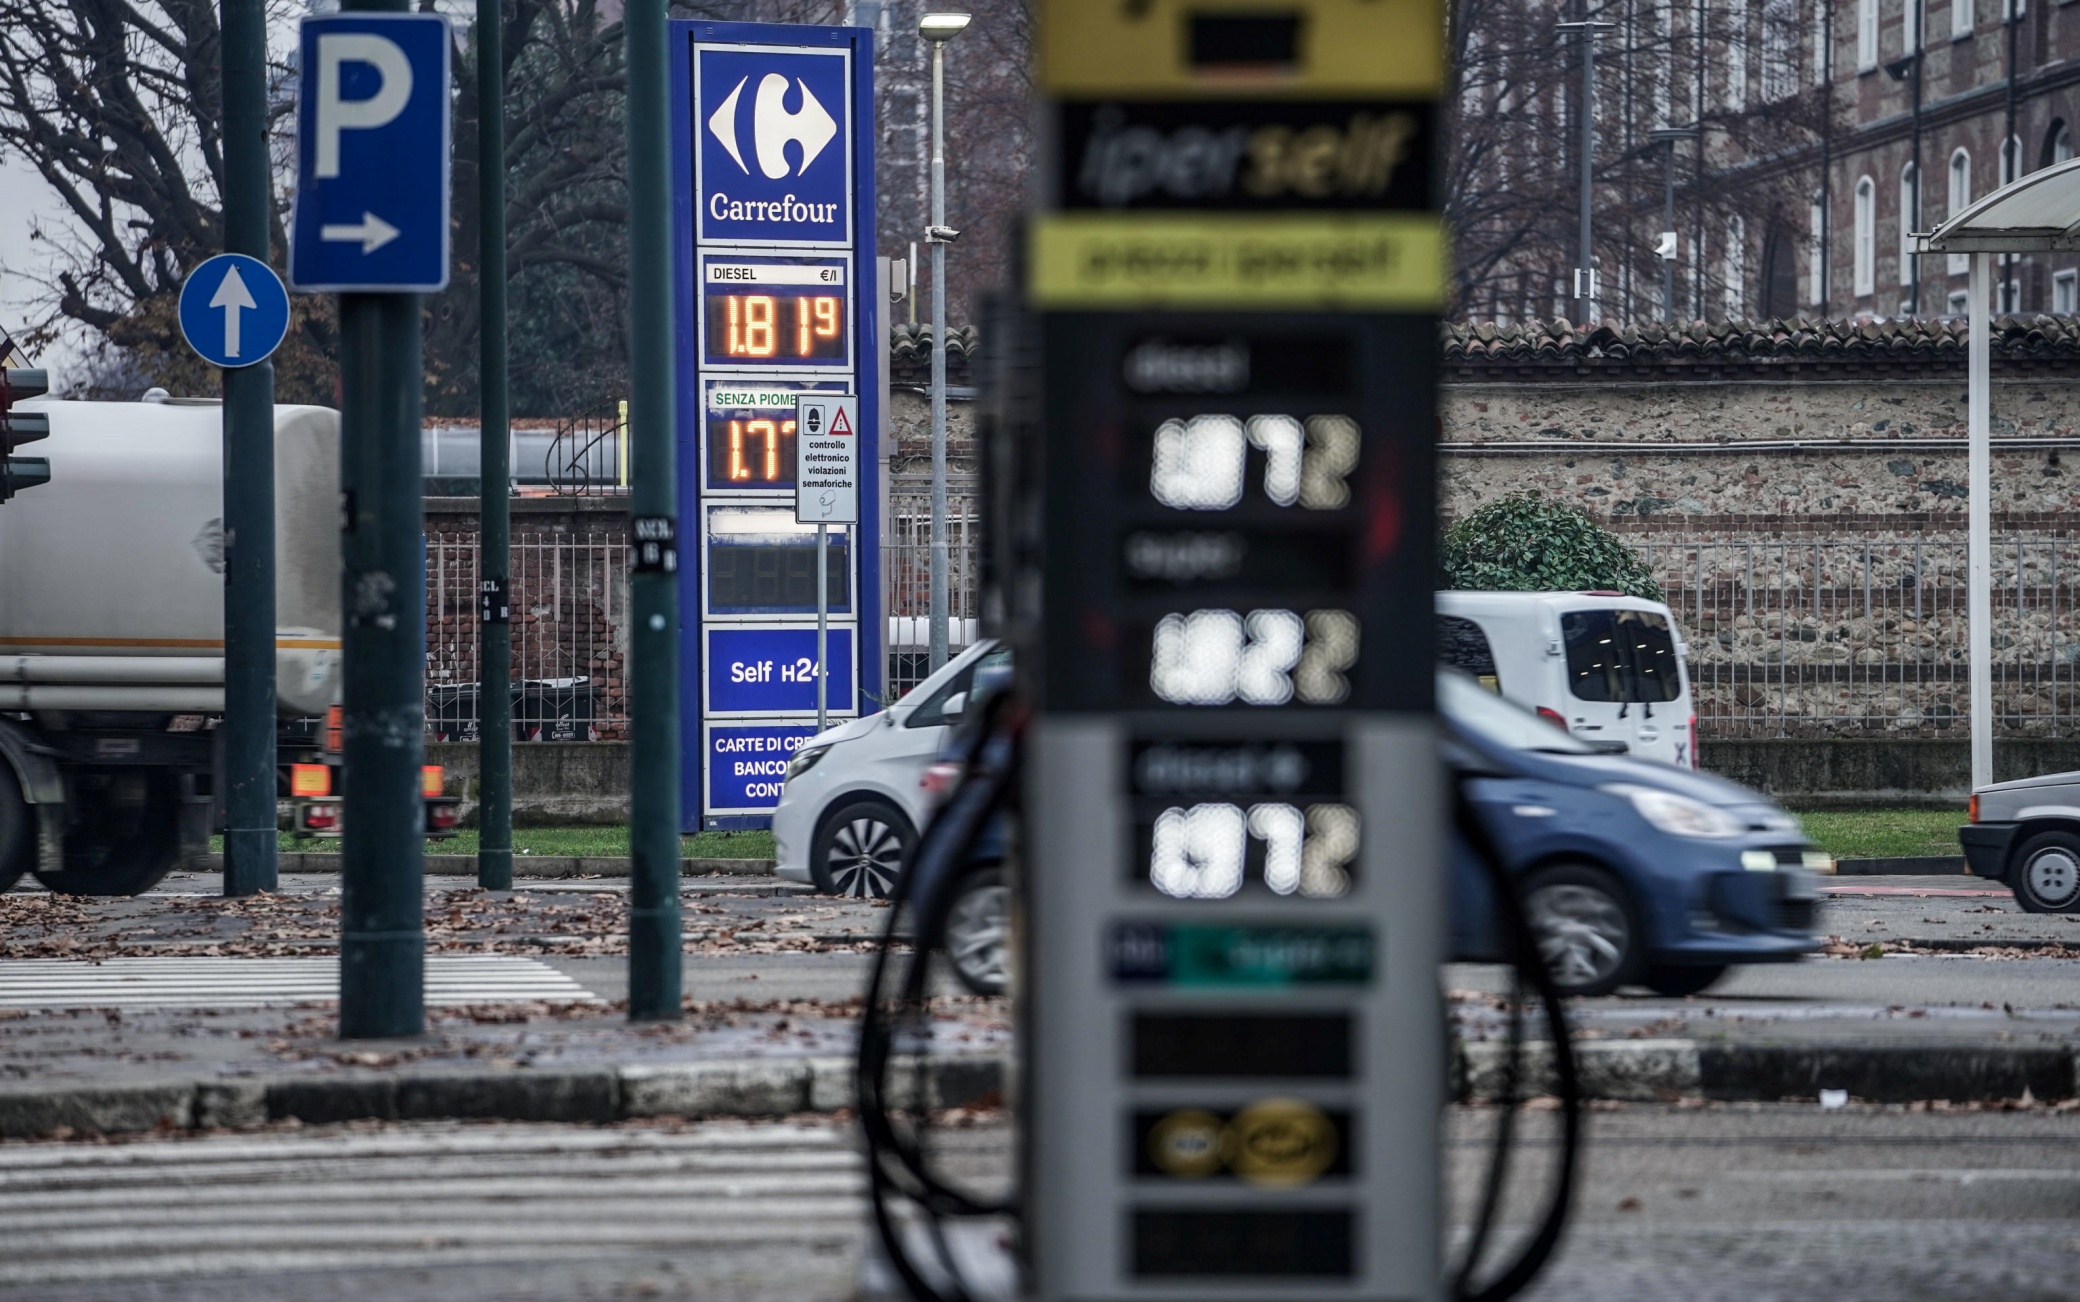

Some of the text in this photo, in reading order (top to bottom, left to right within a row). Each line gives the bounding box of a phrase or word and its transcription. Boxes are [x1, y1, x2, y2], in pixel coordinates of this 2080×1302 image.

[315, 33, 414, 178] P
[710, 192, 838, 223] Carrefour
[714, 267, 757, 280] DIESEL
[716, 392, 756, 405] SENZA
[731, 420, 796, 479] 1.7
[809, 440, 846, 449] controllo
[805, 452, 850, 462] elettronico
[808, 466, 846, 475] violazioni
[802, 479, 852, 488] semaforiche
[731, 660, 773, 683] Self
[715, 737, 764, 753] CARTE
[767, 736, 781, 751] DI
[734, 760, 791, 776] BANCO
